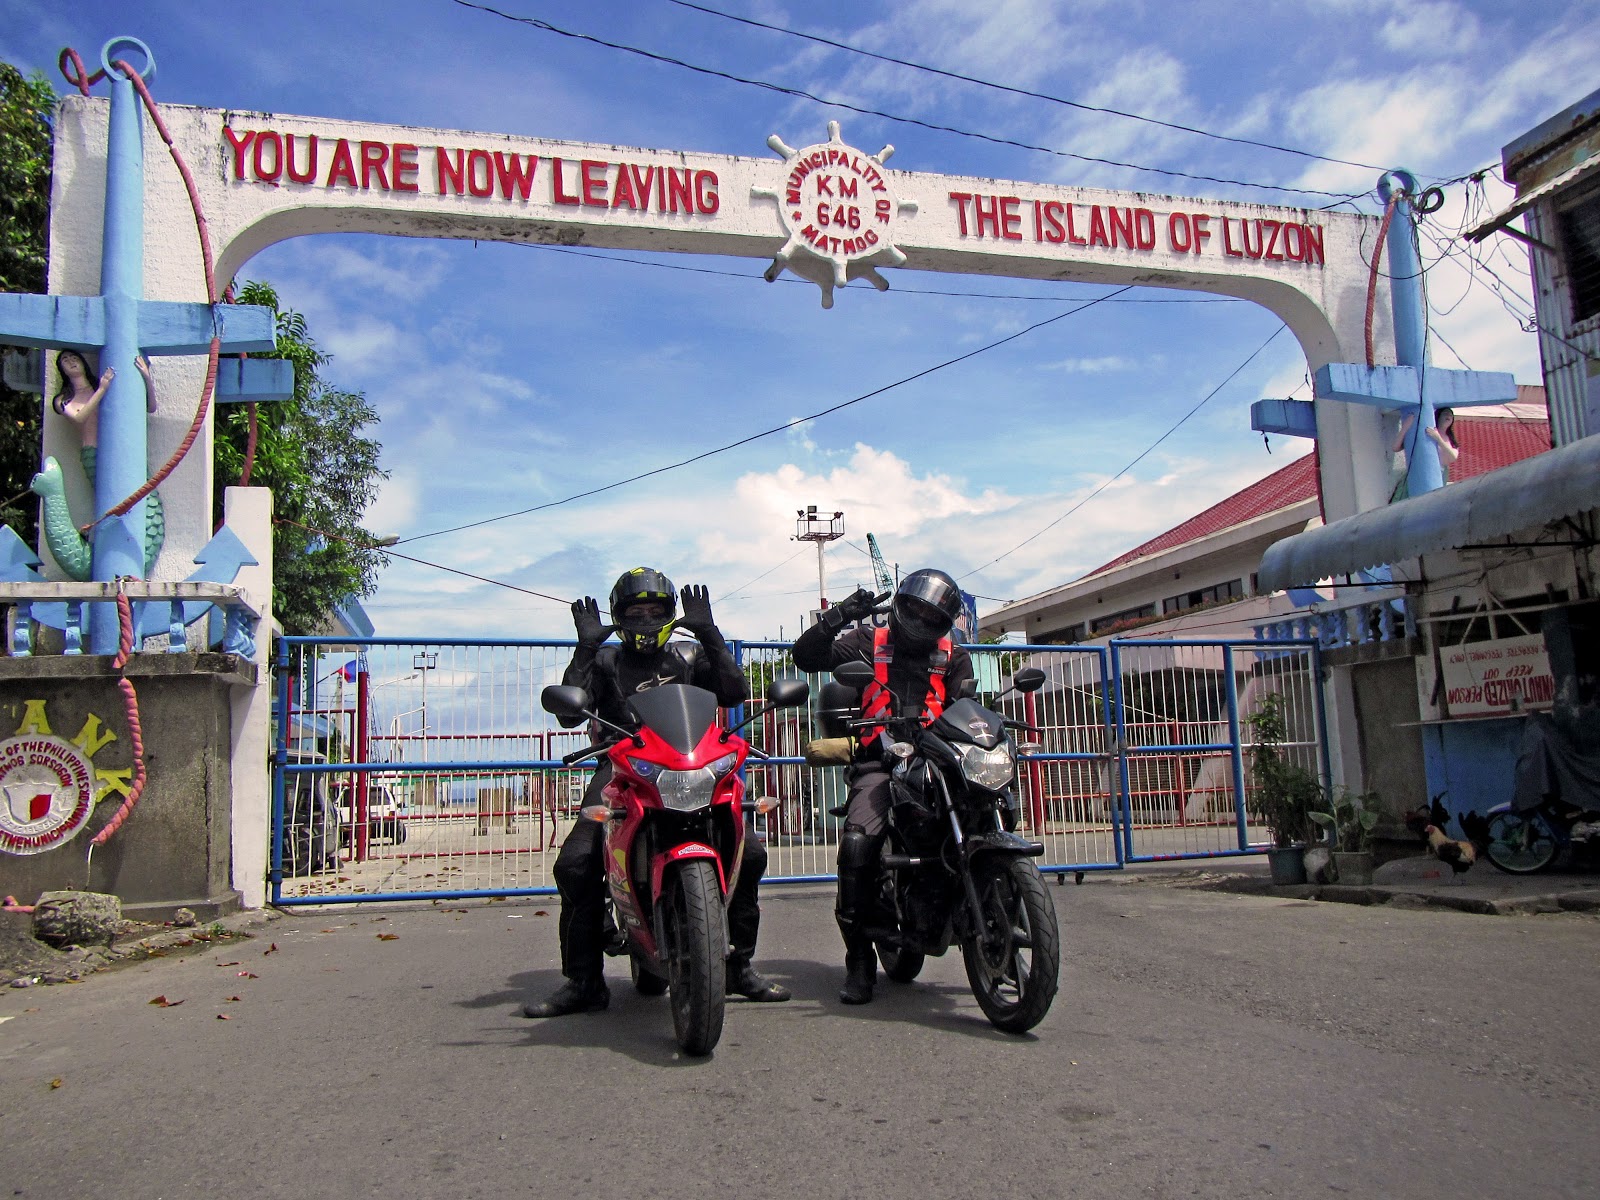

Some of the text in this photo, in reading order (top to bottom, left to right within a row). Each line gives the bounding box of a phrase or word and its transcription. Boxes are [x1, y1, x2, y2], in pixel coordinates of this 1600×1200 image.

[222, 126, 719, 214] YOU ARE NOW LEAVING
[786, 150, 890, 225] MUNICIPALITY OF
[816, 174, 858, 198] KM
[817, 202, 861, 230] 646
[949, 192, 1325, 265] THE ISLAND OF LUZON
[801, 224, 879, 254] MATNOG
[1482, 665, 1534, 680] KEEP OUT
[1447, 685, 1482, 704] PERSON
[6, 743, 20, 756] OF
[30, 754, 73, 787] SORSOGON
